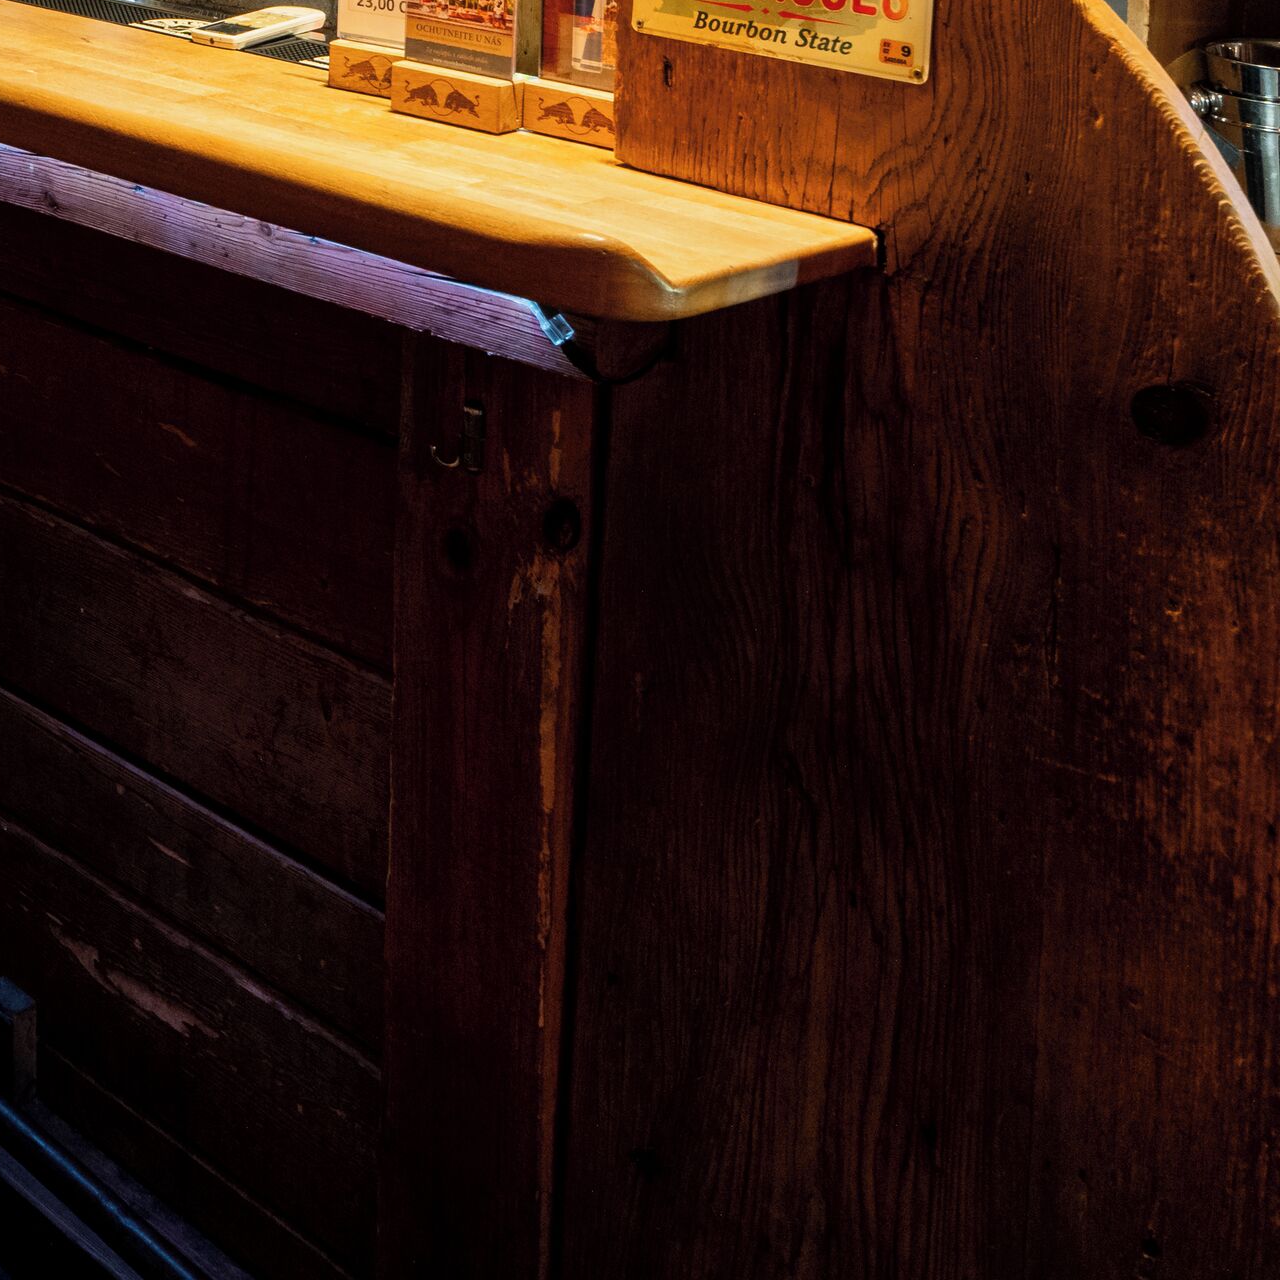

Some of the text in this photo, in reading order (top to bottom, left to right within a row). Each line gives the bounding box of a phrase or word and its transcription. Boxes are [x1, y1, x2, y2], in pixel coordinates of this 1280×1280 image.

[693, 10, 853, 55] Bourbon State
[484, 34, 502, 47] NÁS
[901, 45, 912, 57] 9
